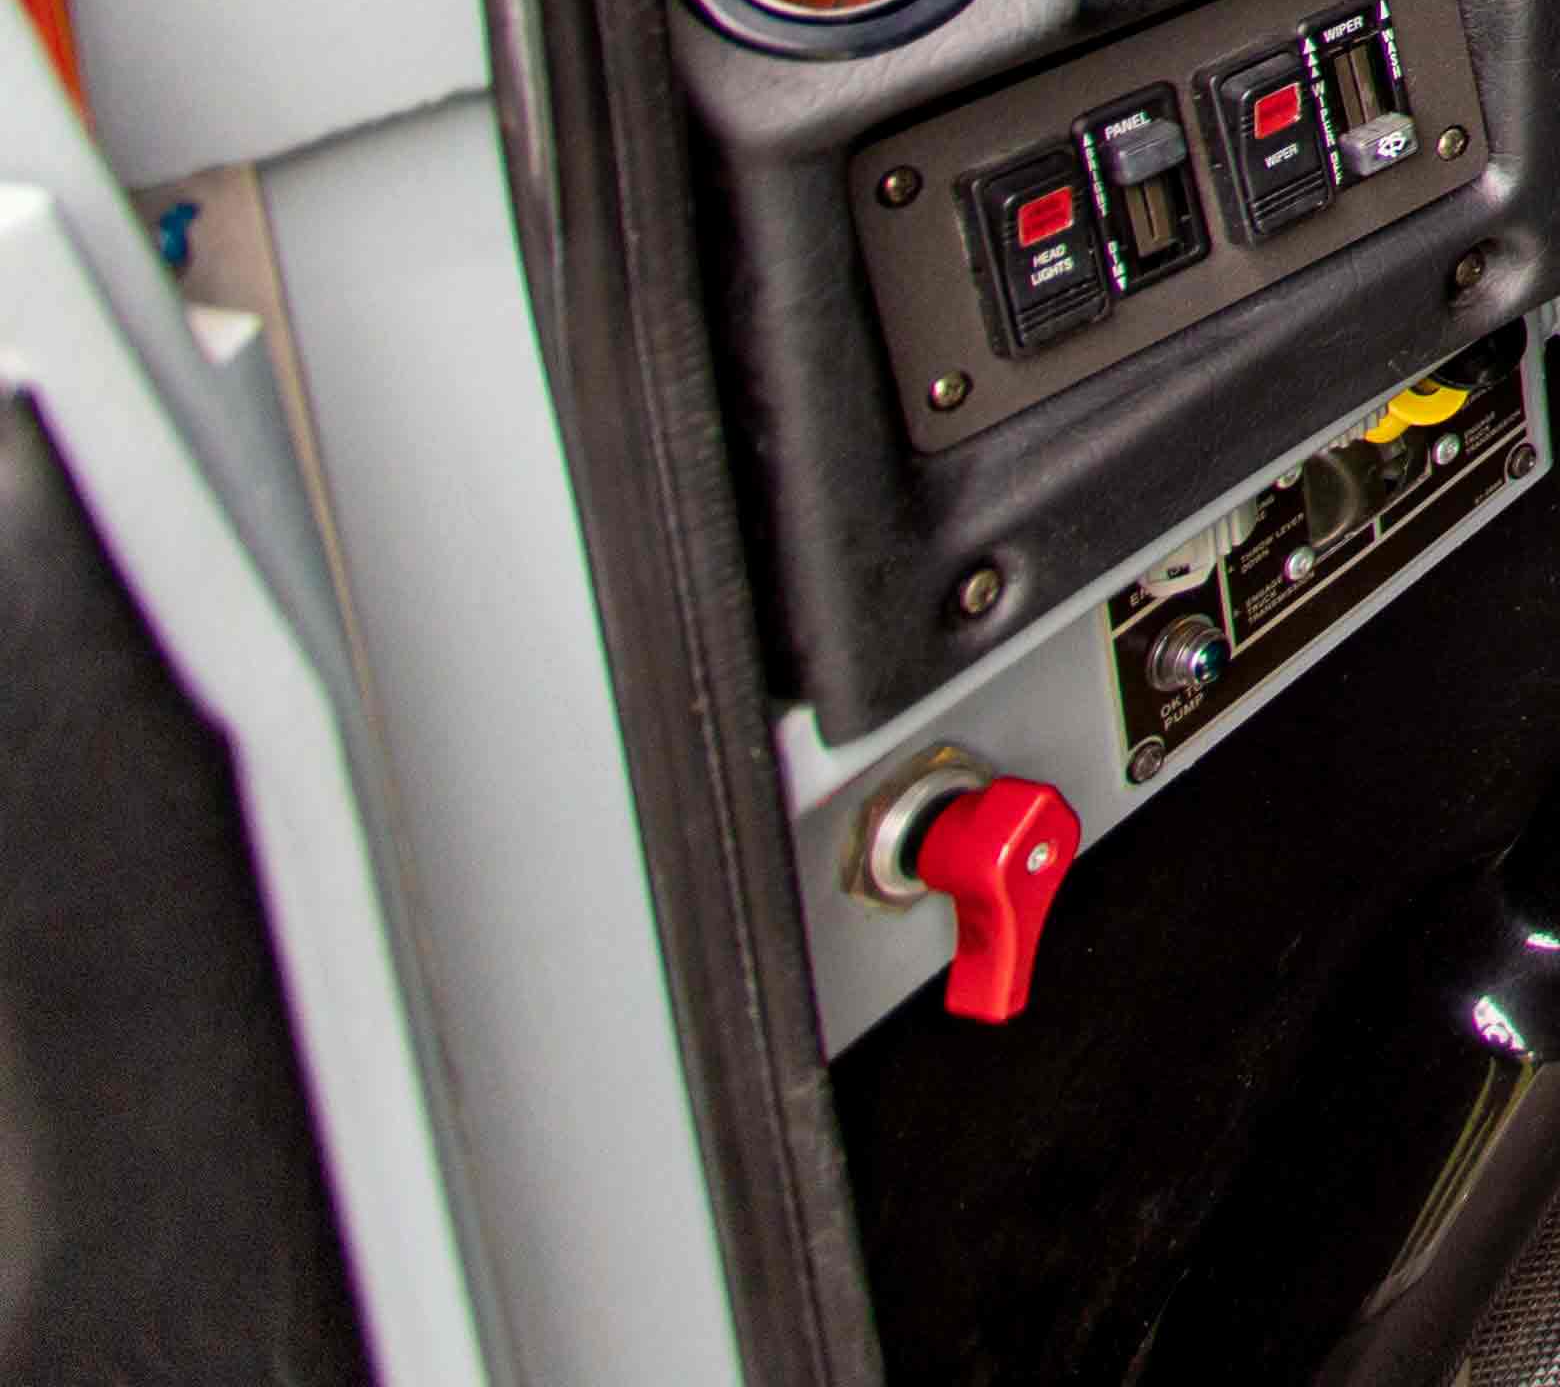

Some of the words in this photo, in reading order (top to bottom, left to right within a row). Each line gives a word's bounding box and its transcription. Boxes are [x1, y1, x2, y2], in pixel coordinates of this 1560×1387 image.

[1322, 15, 1364, 43] WIPER
[1104, 111, 1151, 141] PANEL
[1264, 142, 1299, 169] WIPER
[1032, 242, 1067, 267] HEAD
[1030, 256, 1074, 287] LIGHTS
[1161, 693, 1182, 718] OK
[1164, 692, 1204, 731] PUMP
